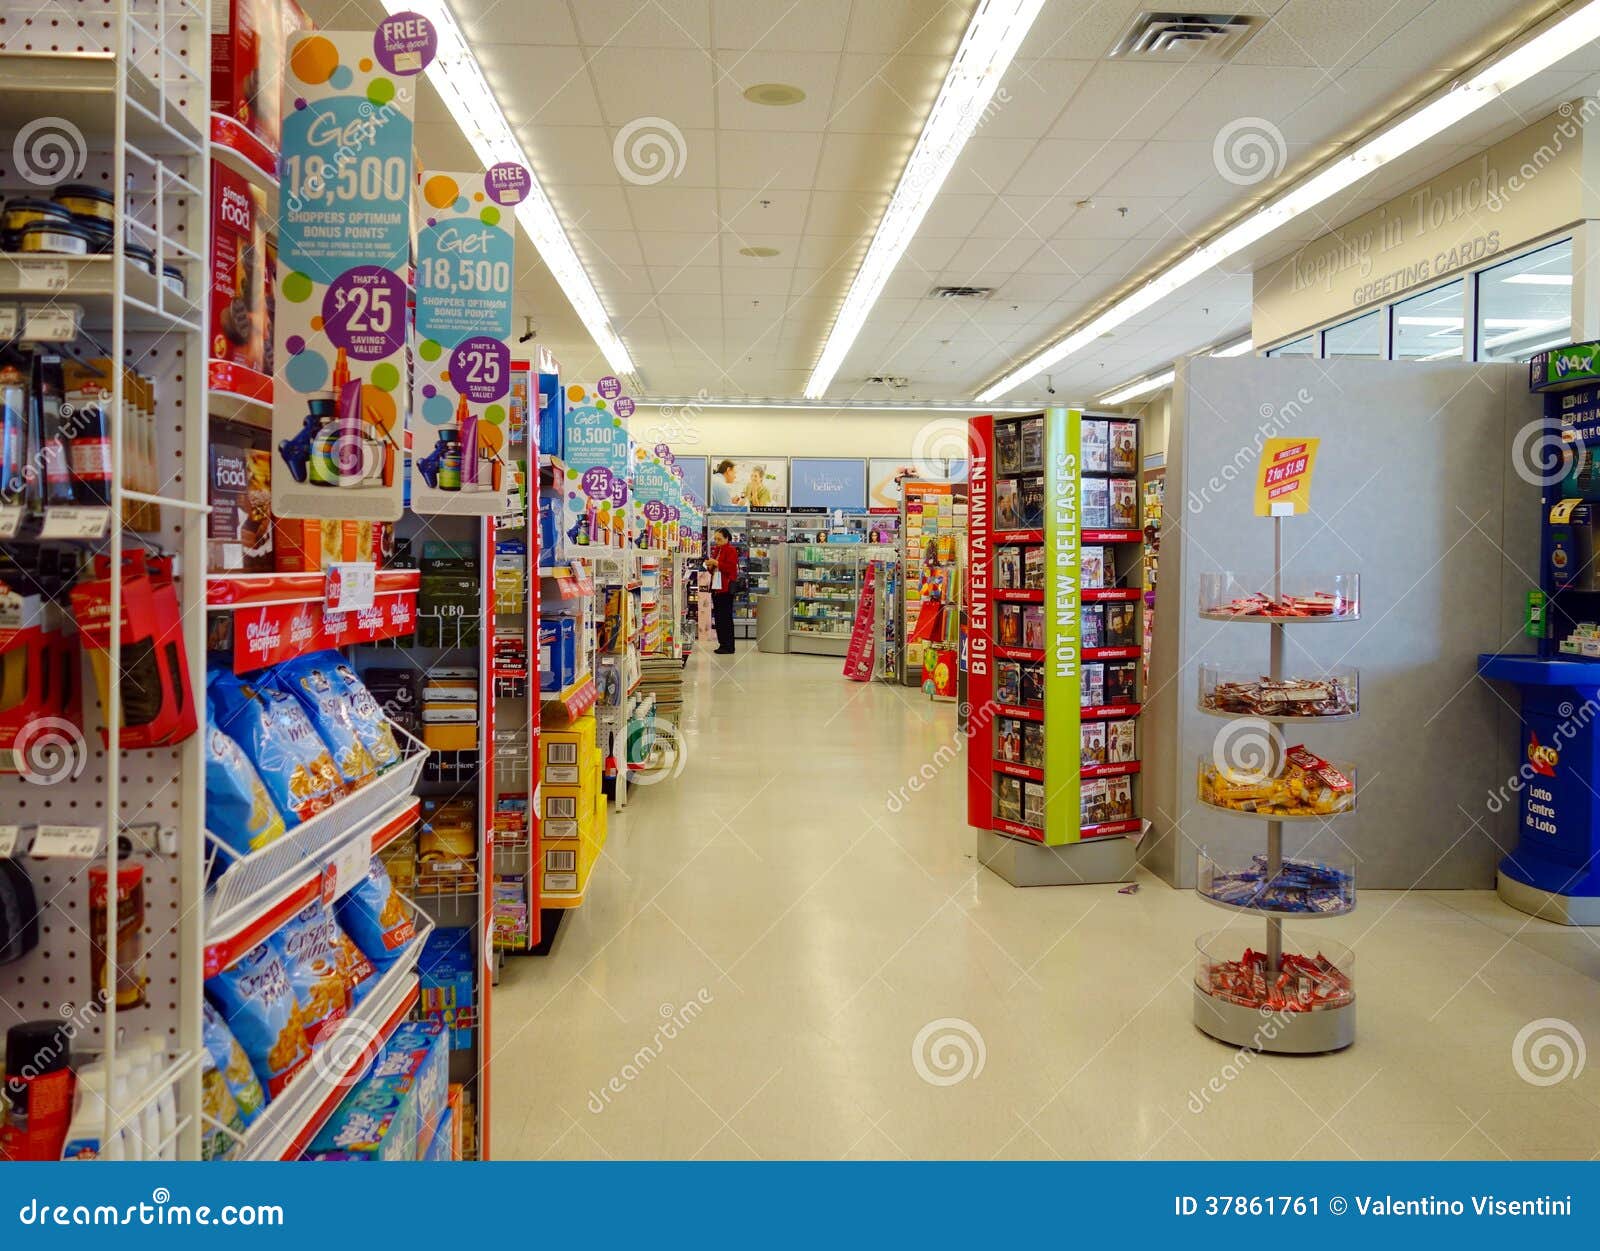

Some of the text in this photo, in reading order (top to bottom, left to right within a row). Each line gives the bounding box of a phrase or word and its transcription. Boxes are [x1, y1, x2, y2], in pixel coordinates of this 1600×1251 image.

[384, 19, 428, 41] FREE
[307, 111, 377, 147] Get
[287, 154, 405, 206] 18,500
[491, 167, 524, 181] FREE
[223, 185, 248, 211] simply
[221, 197, 250, 231] food
[287, 211, 402, 225] SHOPPERS OPTIMUM
[1290, 153, 1501, 294] Keeping in Touch
[303, 225, 341, 238] BONUS
[436, 228, 495, 254] Get
[422, 257, 510, 294] 18,500
[1353, 230, 1501, 306] GREETING CARDS
[352, 274, 387, 285] THAT'S A
[334, 286, 392, 333] $25
[422, 296, 465, 307] SHOPPERS
[434, 307, 462, 317] BONUS
[350, 335, 386, 354] SAVINGS VALUE!
[458, 351, 500, 384] $25
[1555, 354, 1594, 377] MAX
[469, 385, 496, 393] SAVINGS
[574, 411, 604, 425] Get
[567, 427, 612, 446] 18,500
[216, 455, 243, 470] simply
[1266, 458, 1305, 483] 2 for $1.99
[216, 466, 247, 487] food
[586, 473, 608, 491] $25
[971, 454, 987, 675] BIG ENTERTAINMENT
[1056, 453, 1076, 677] HOT NEW RELEASES
[434, 604, 465, 617] LCBO
[247, 606, 271, 662] only
[249, 635, 281, 653] SHOPPERS
[1097, 650, 1127, 658] entertainment
[1096, 708, 1126, 716] entertainment
[1096, 766, 1126, 775] entertainment
[1529, 785, 1553, 802] Lotto
[1527, 800, 1555, 818] Centre
[1096, 824, 1126, 834] entertainment
[1526, 814, 1557, 835] de Loto
